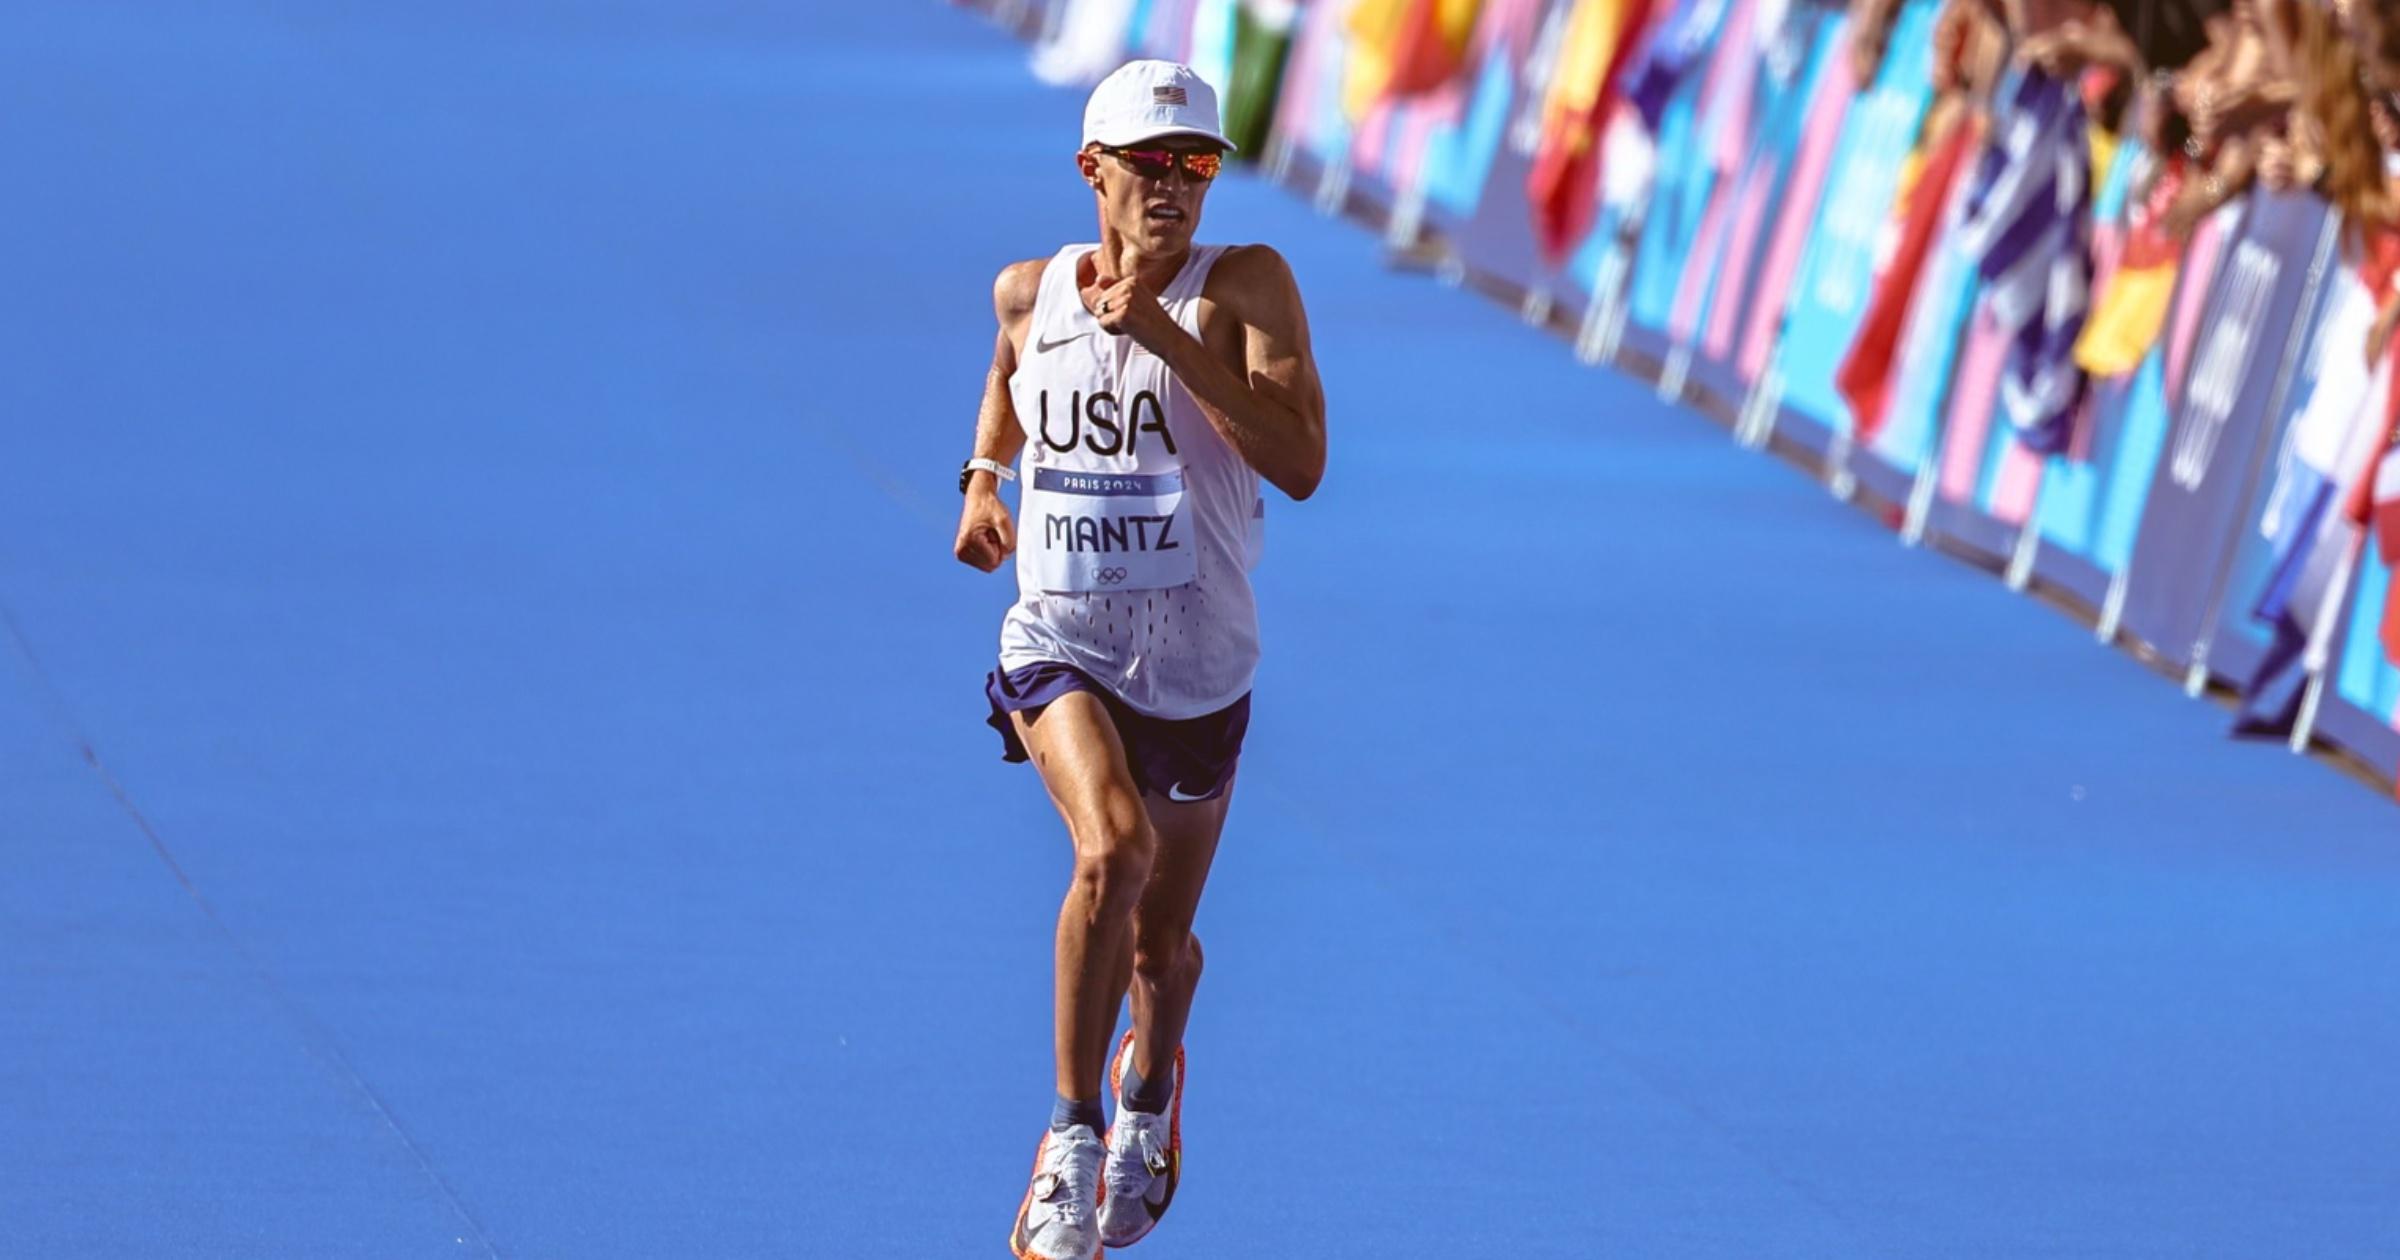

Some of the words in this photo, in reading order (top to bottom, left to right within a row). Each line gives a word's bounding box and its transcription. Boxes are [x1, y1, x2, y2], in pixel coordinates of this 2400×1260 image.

[1040, 390, 1177, 456] USA
[1064, 476, 1100, 490] PARIS
[1103, 479, 1142, 490] 2024
[1046, 514, 1178, 552] MANTZ
